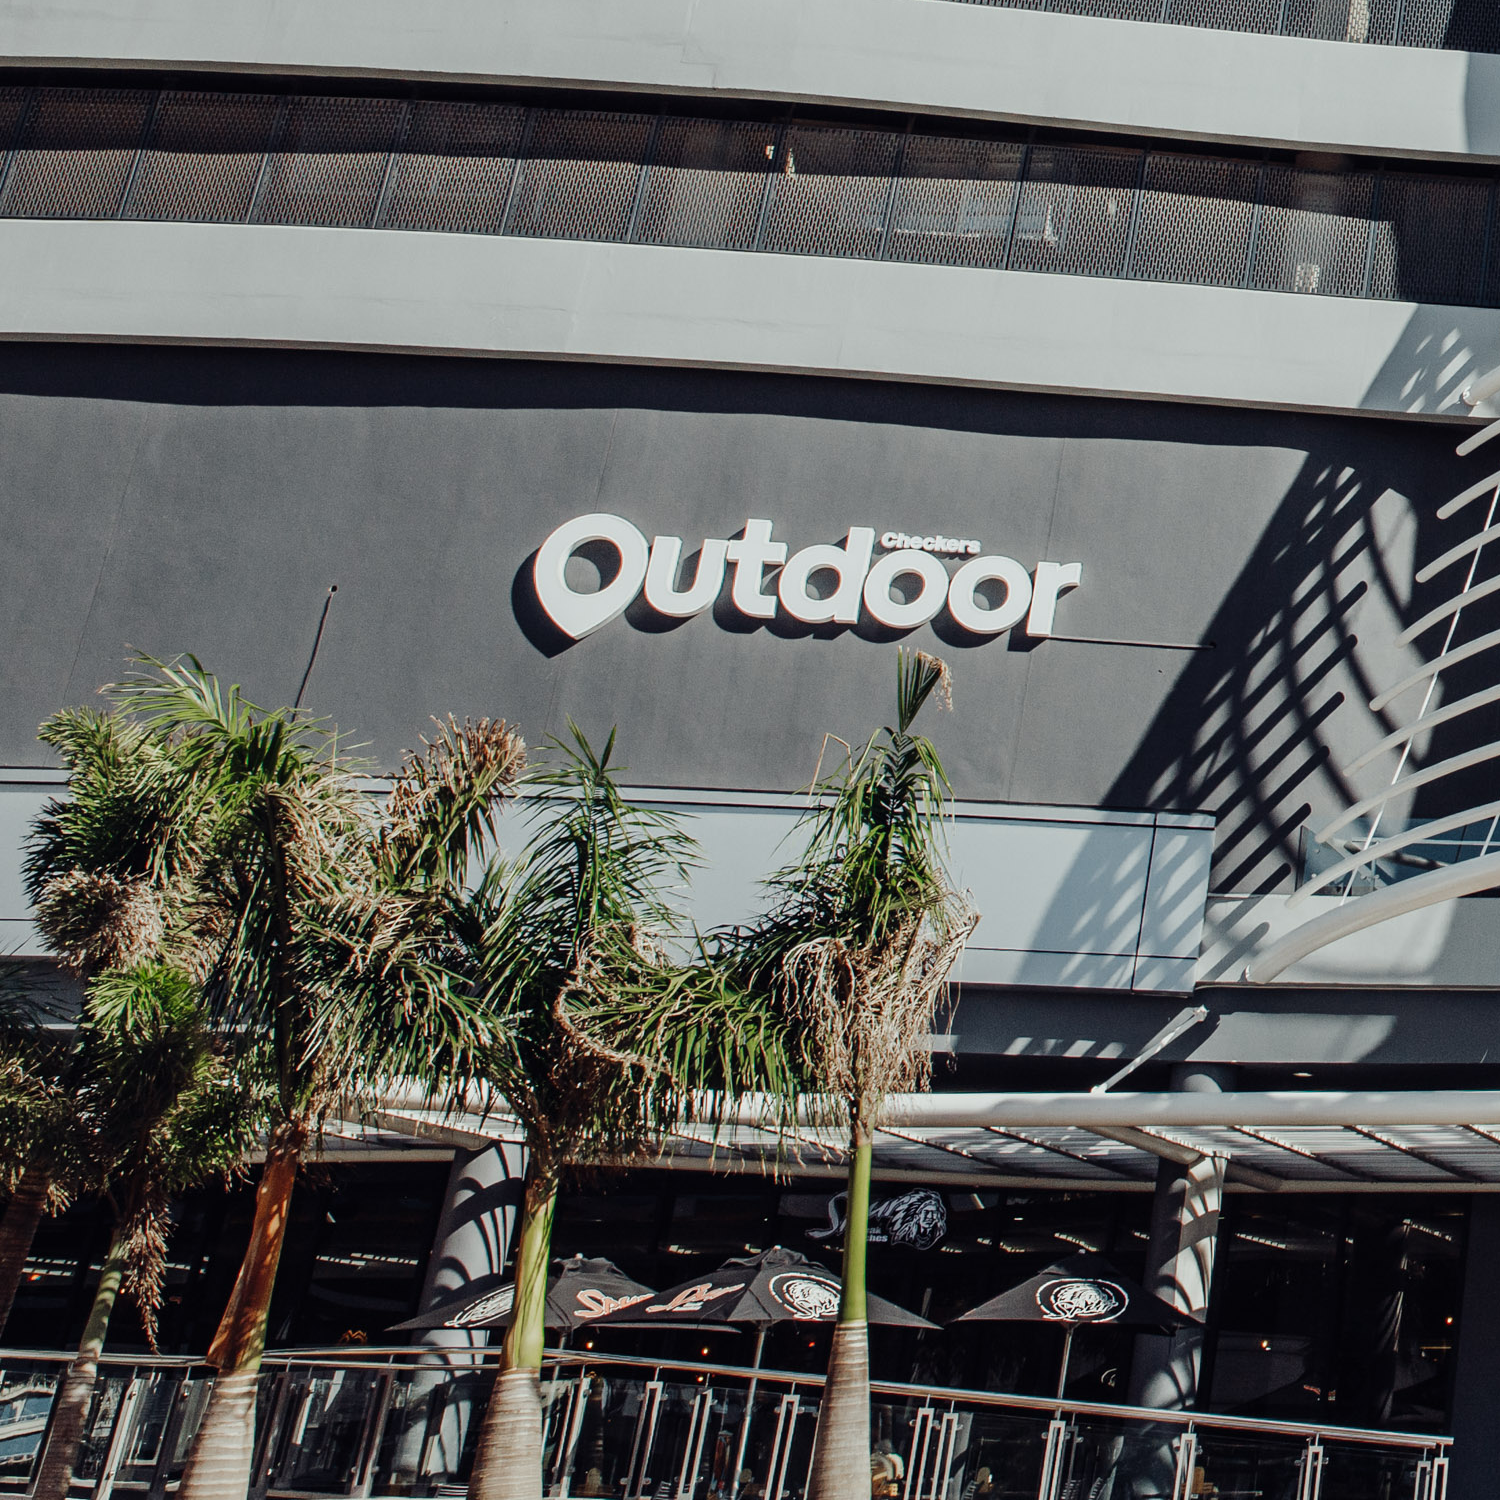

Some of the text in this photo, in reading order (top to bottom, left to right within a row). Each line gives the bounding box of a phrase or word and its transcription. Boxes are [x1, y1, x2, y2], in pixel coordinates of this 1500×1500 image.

[881, 531, 982, 554] Checkers
[533, 513, 1082, 640] Outdoor
[793, 1299, 841, 1319] Spu
